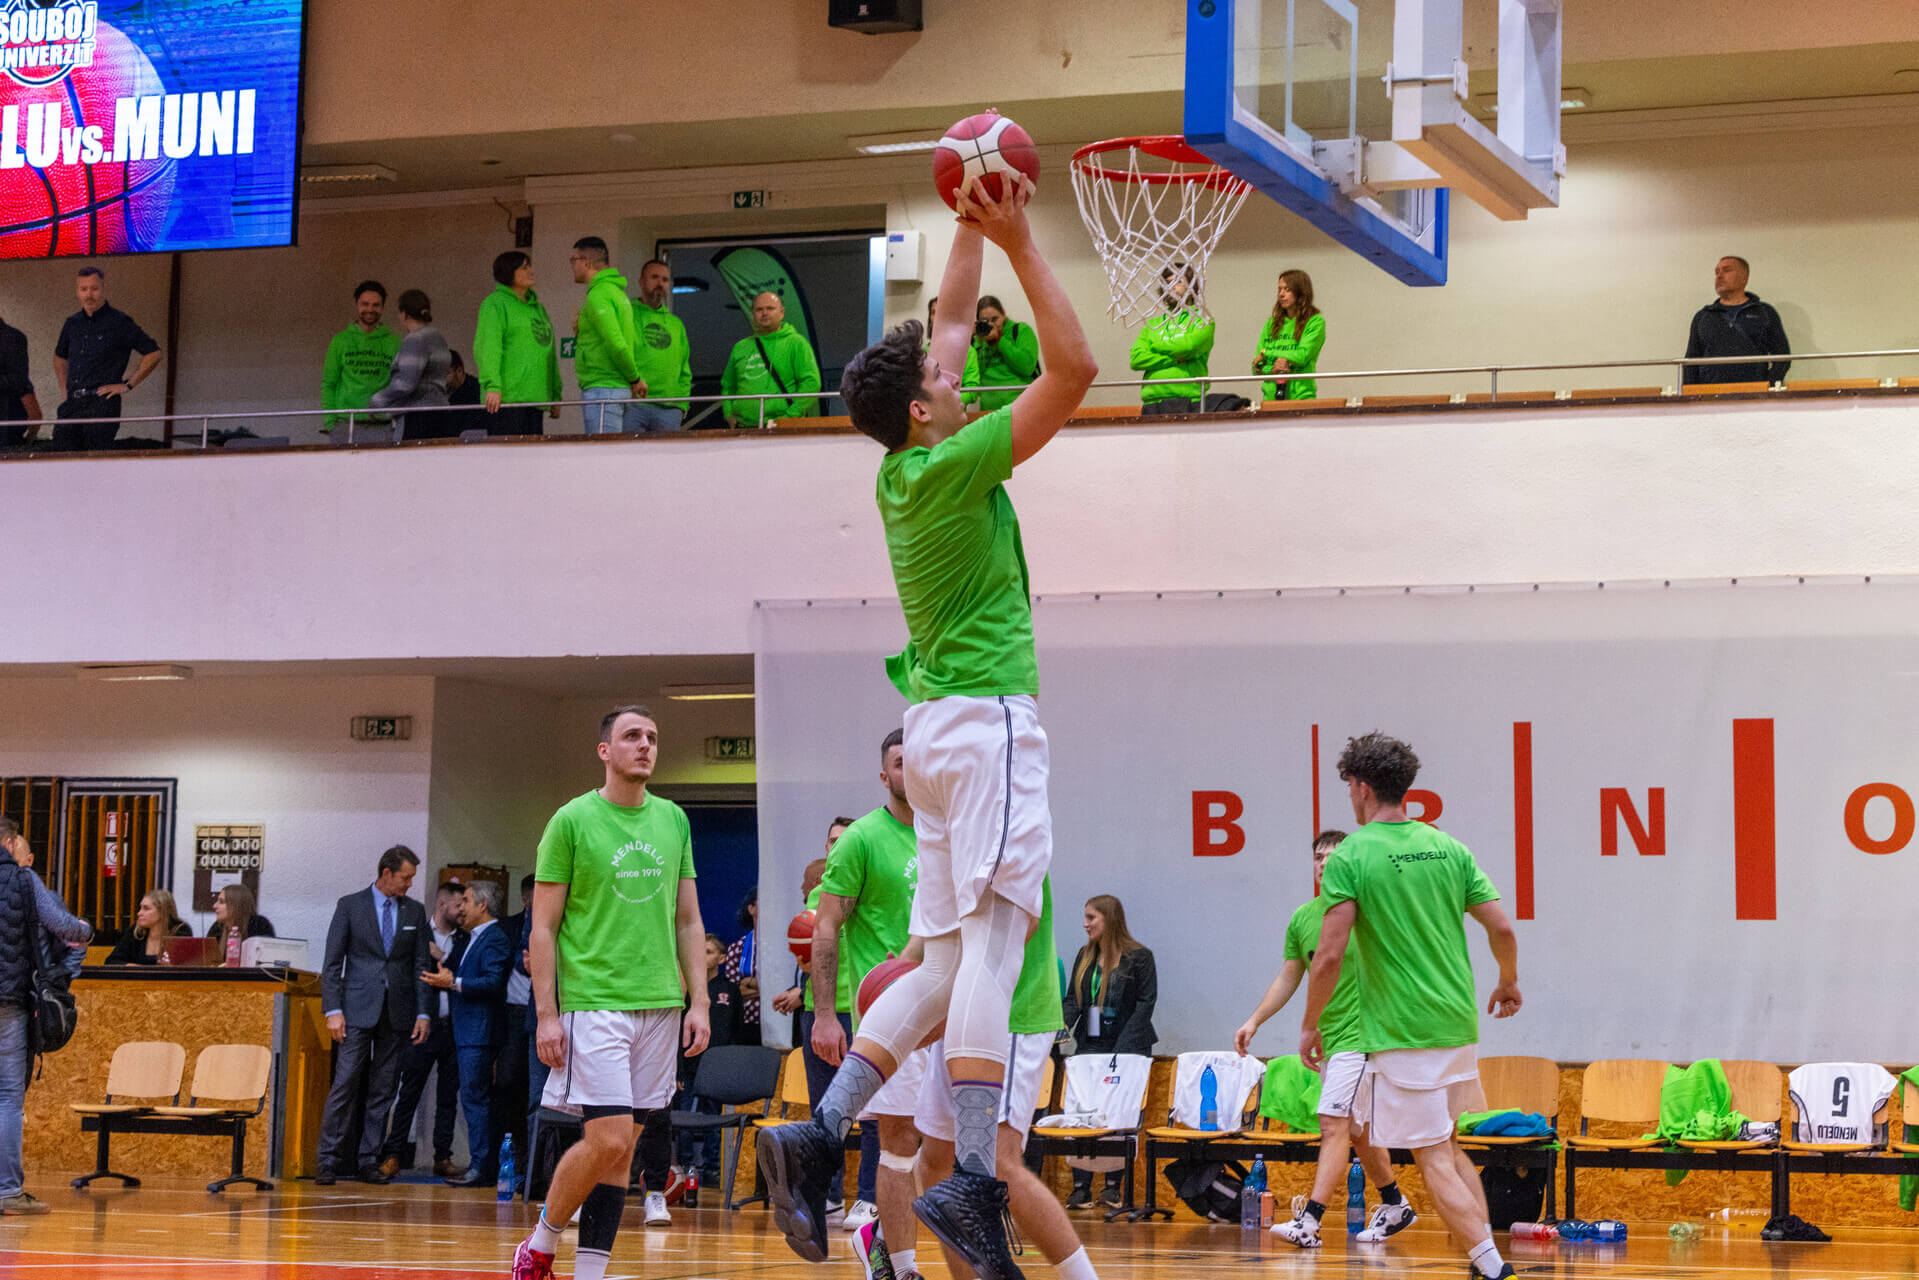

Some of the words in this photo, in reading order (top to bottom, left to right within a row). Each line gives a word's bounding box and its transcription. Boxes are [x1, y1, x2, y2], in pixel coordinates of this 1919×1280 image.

[113, 89, 256, 162] MUNI
[611, 840, 664, 867] MENDELU
[1396, 851, 1447, 862] MENDELU
[616, 870, 639, 878] since
[642, 868, 661, 877] 1919
[1109, 1053, 1117, 1072] 4
[1831, 1076, 1850, 1117] 5
[1817, 1125, 1858, 1140] MENDELU
